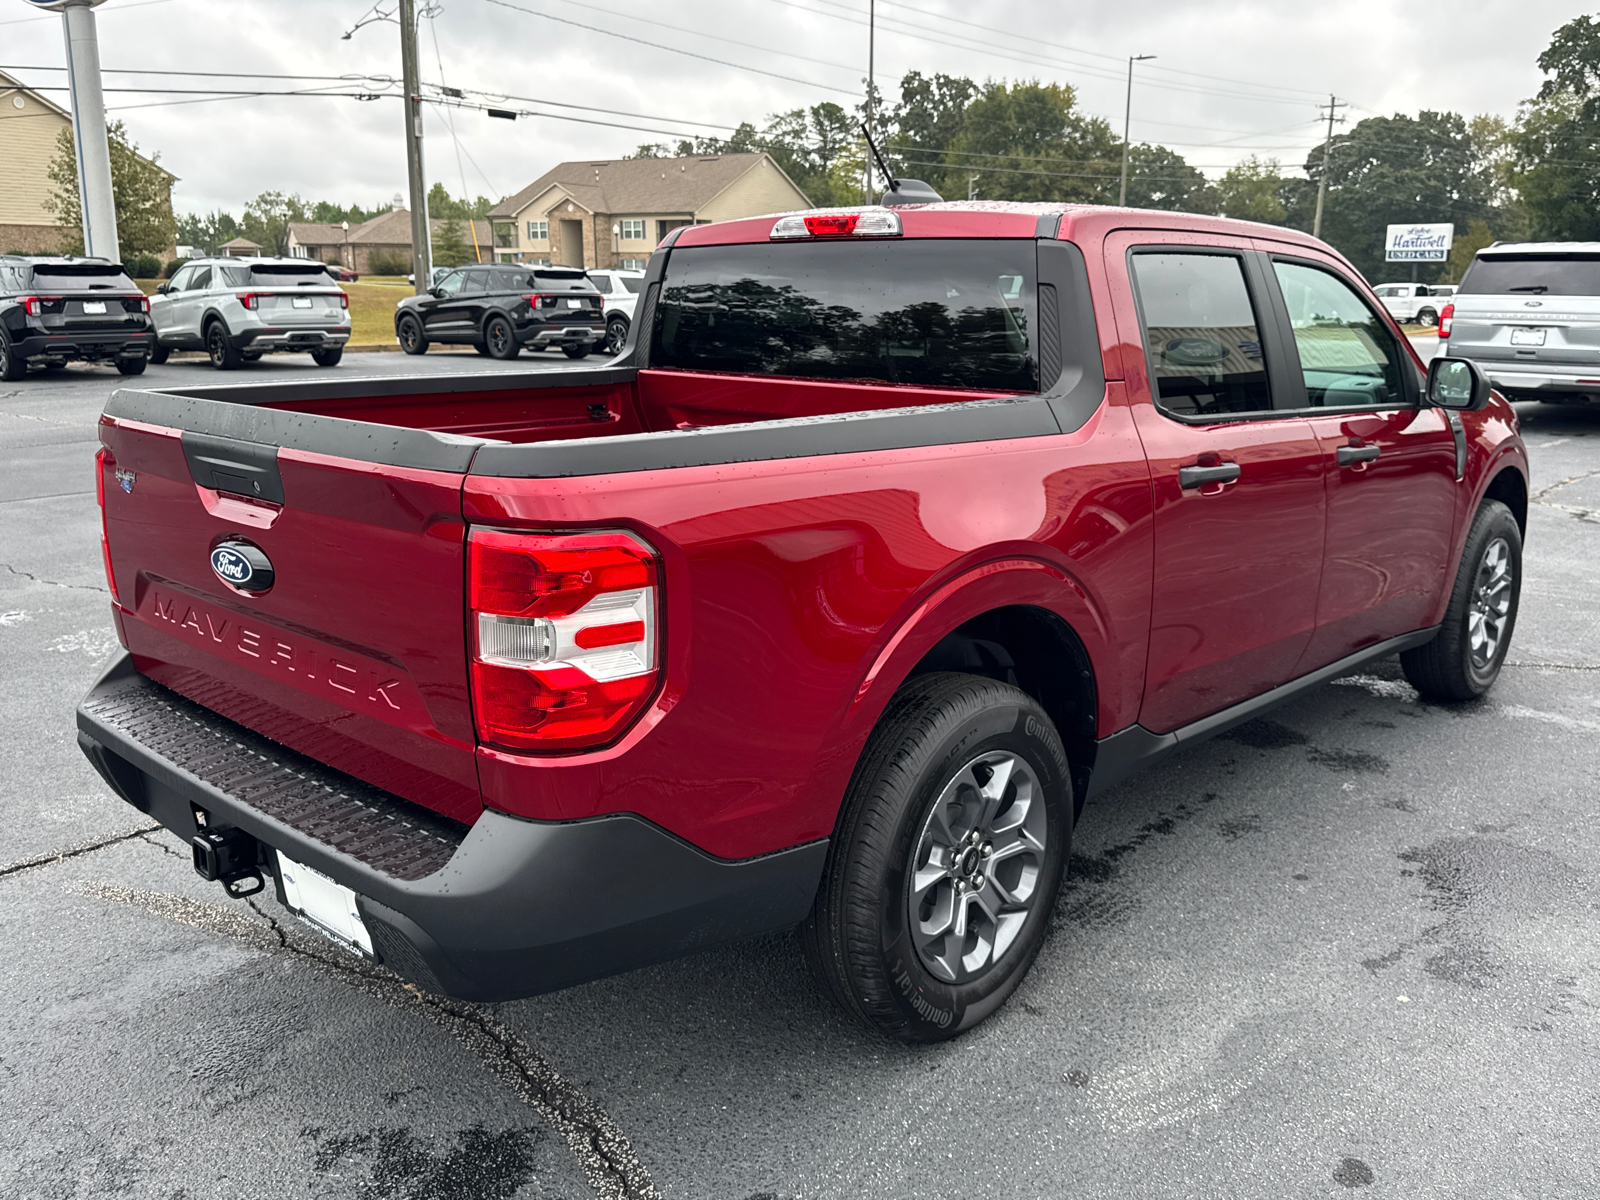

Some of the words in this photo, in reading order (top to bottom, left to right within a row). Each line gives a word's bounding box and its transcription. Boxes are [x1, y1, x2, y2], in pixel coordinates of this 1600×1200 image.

[1390, 251, 1415, 259] USED
[1416, 251, 1442, 259] CARS
[1393, 234, 1446, 249] Hartwell
[217, 551, 244, 579] Ford
[154, 592, 401, 710] MAVERICK
[1025, 714, 1069, 781] Continental
[895, 969, 954, 1029] Continental
